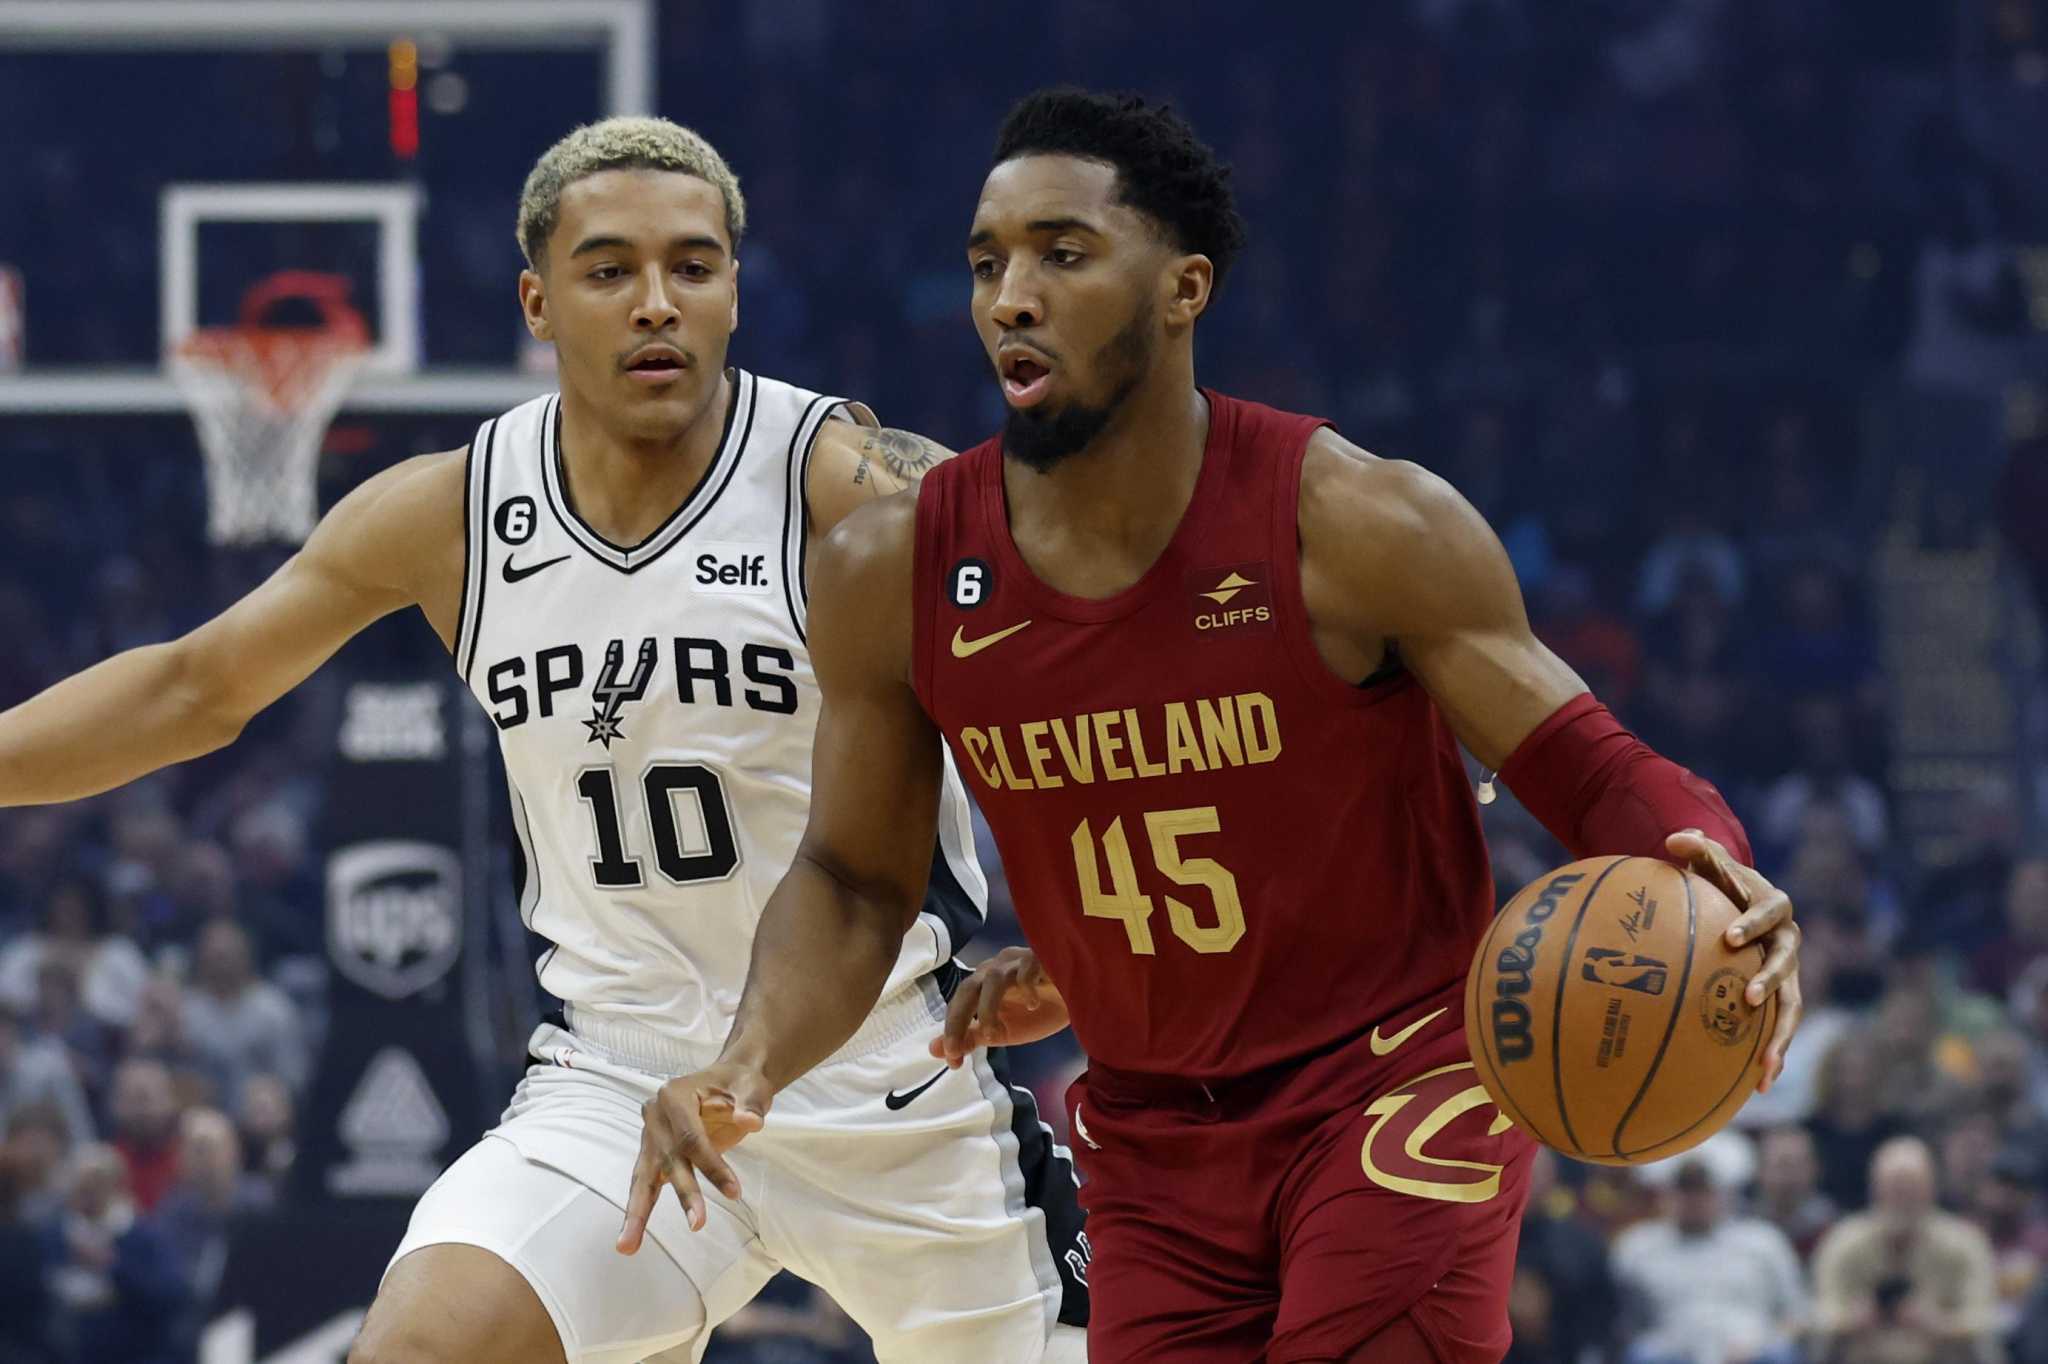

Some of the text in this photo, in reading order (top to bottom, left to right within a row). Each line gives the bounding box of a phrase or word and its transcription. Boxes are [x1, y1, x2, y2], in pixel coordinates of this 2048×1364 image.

[505, 502, 531, 540] 6
[695, 553, 769, 587] Self.
[956, 565, 983, 605] 6
[1194, 606, 1270, 631] CLIFFS
[487, 637, 798, 750] SPURS
[960, 691, 1282, 790] CLEVELAND
[574, 760, 744, 888] 10
[1070, 806, 1247, 956] 45
[1491, 872, 1586, 1067] Wilson
